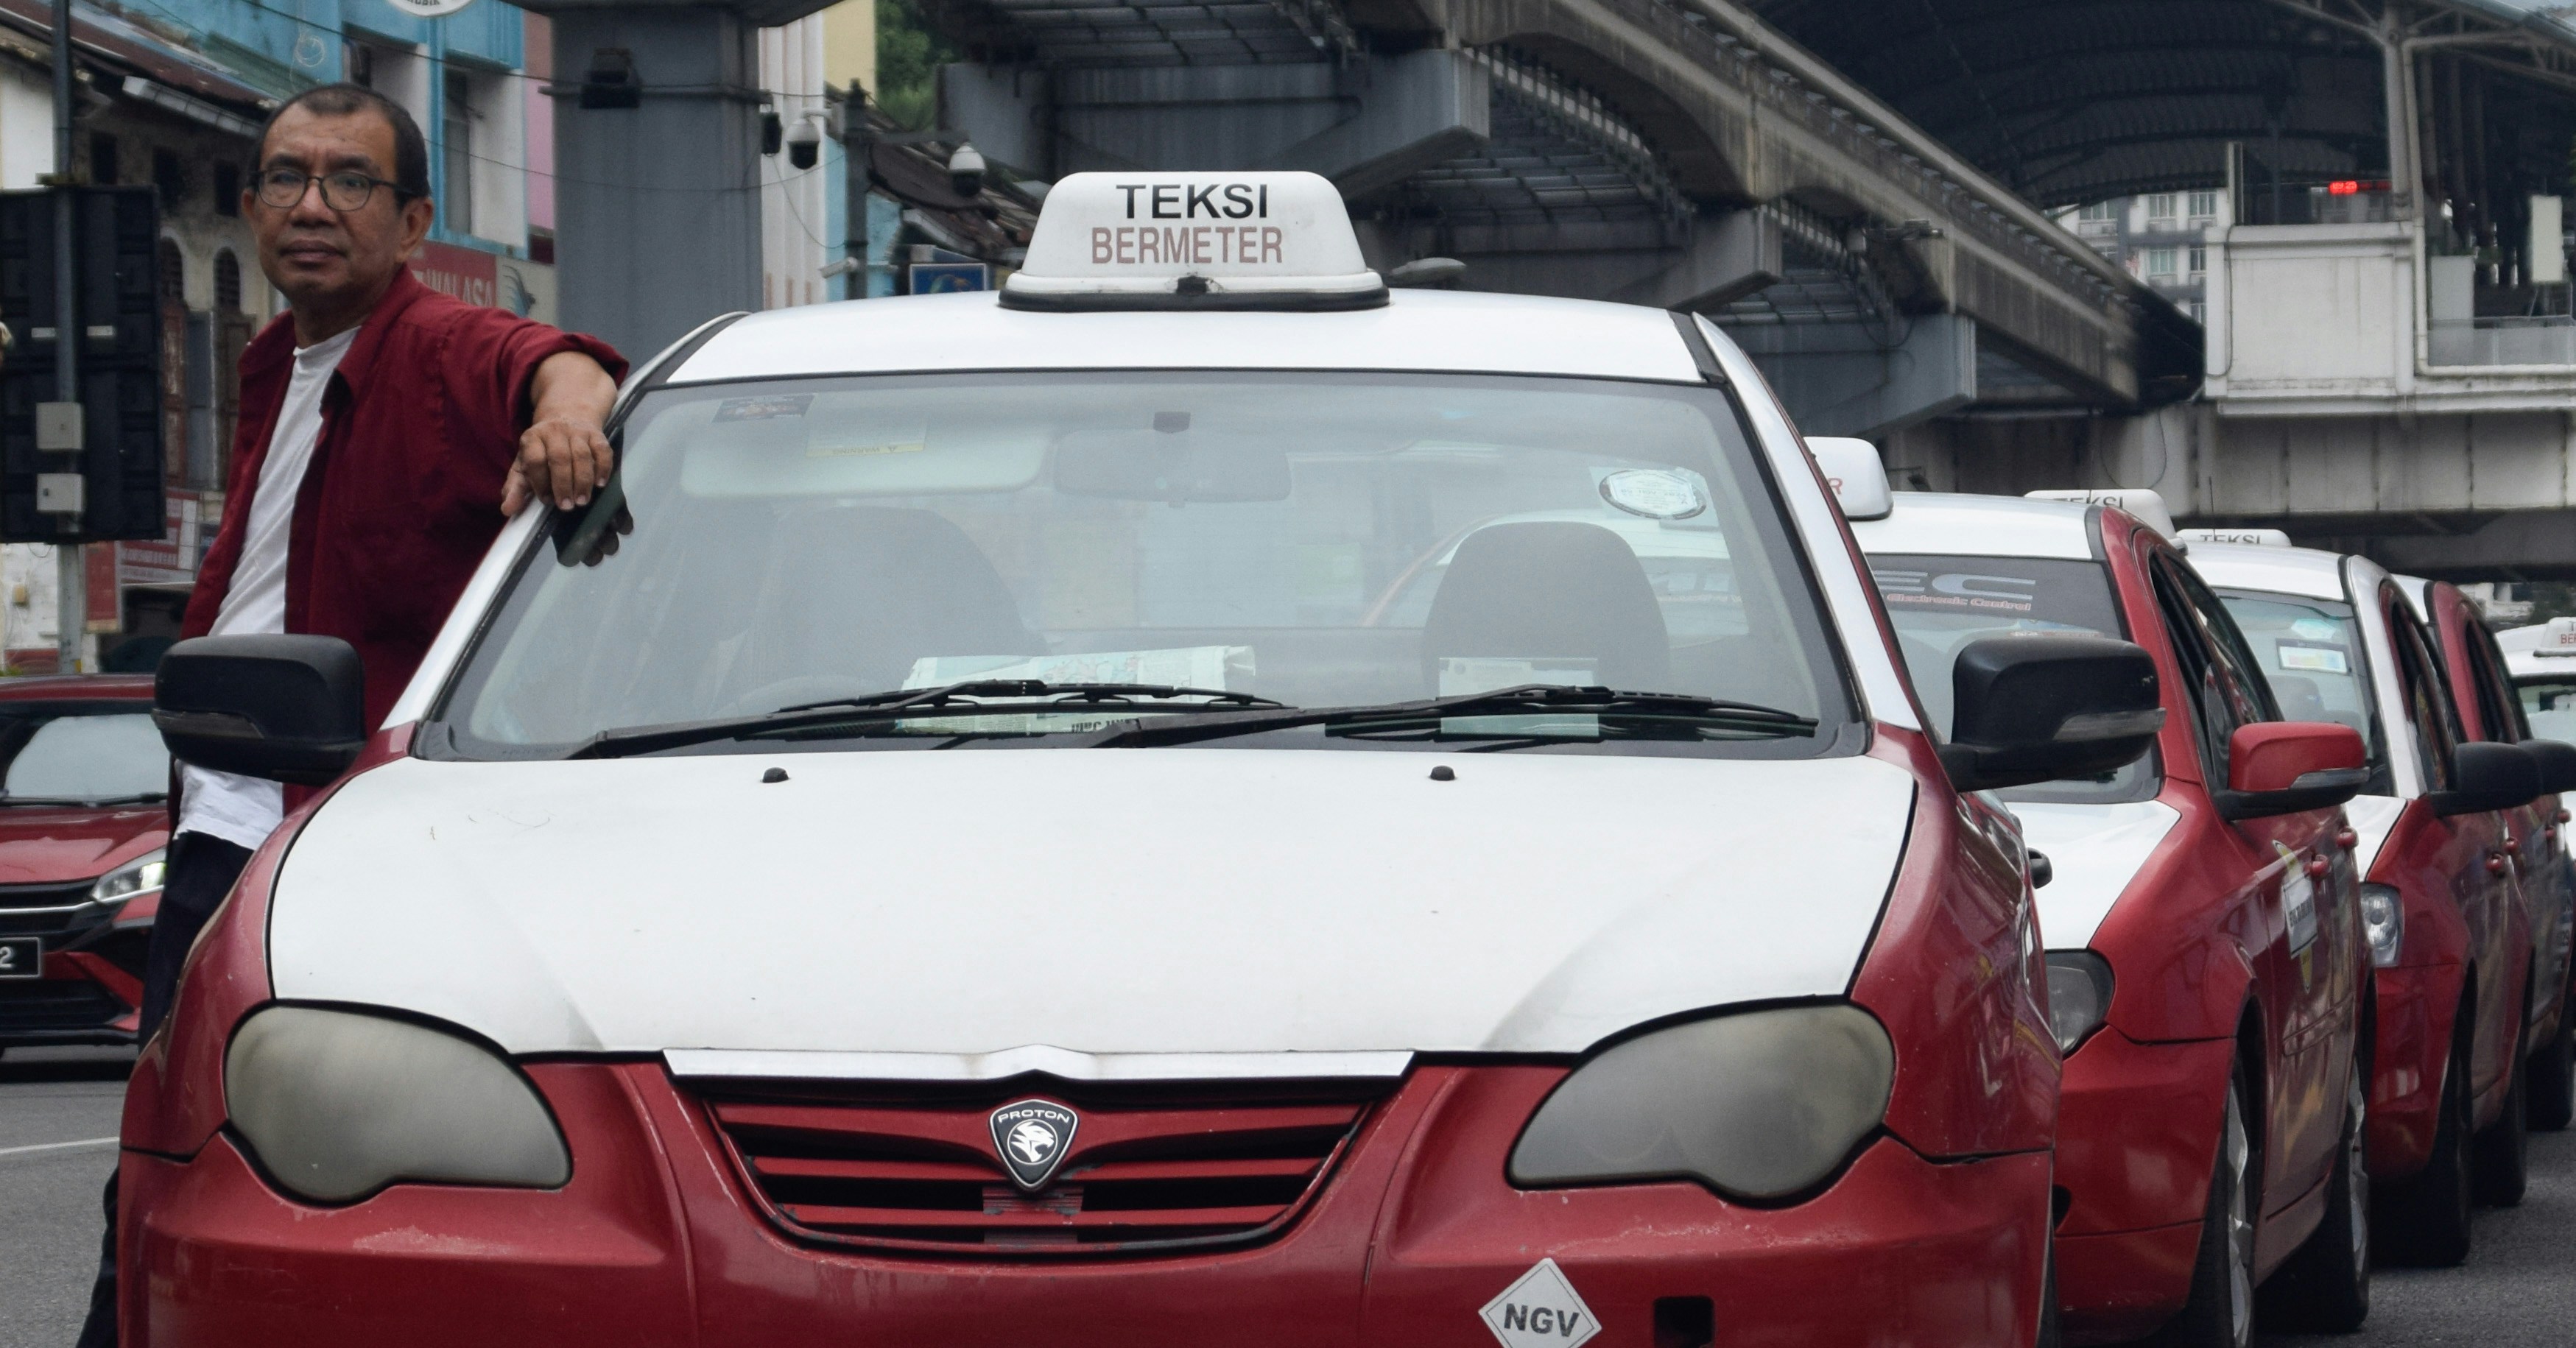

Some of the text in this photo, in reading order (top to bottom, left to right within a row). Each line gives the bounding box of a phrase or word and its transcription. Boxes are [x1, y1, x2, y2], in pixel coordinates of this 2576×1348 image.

[1116, 183, 1267, 219] TEKSI
[1092, 226, 1283, 264] BERMETER
[2053, 496, 2124, 509] KSI
[1887, 593, 2032, 611] Electronic Control
[997, 1109, 1071, 1124] PROTON
[1504, 1302, 1580, 1338] NGV
